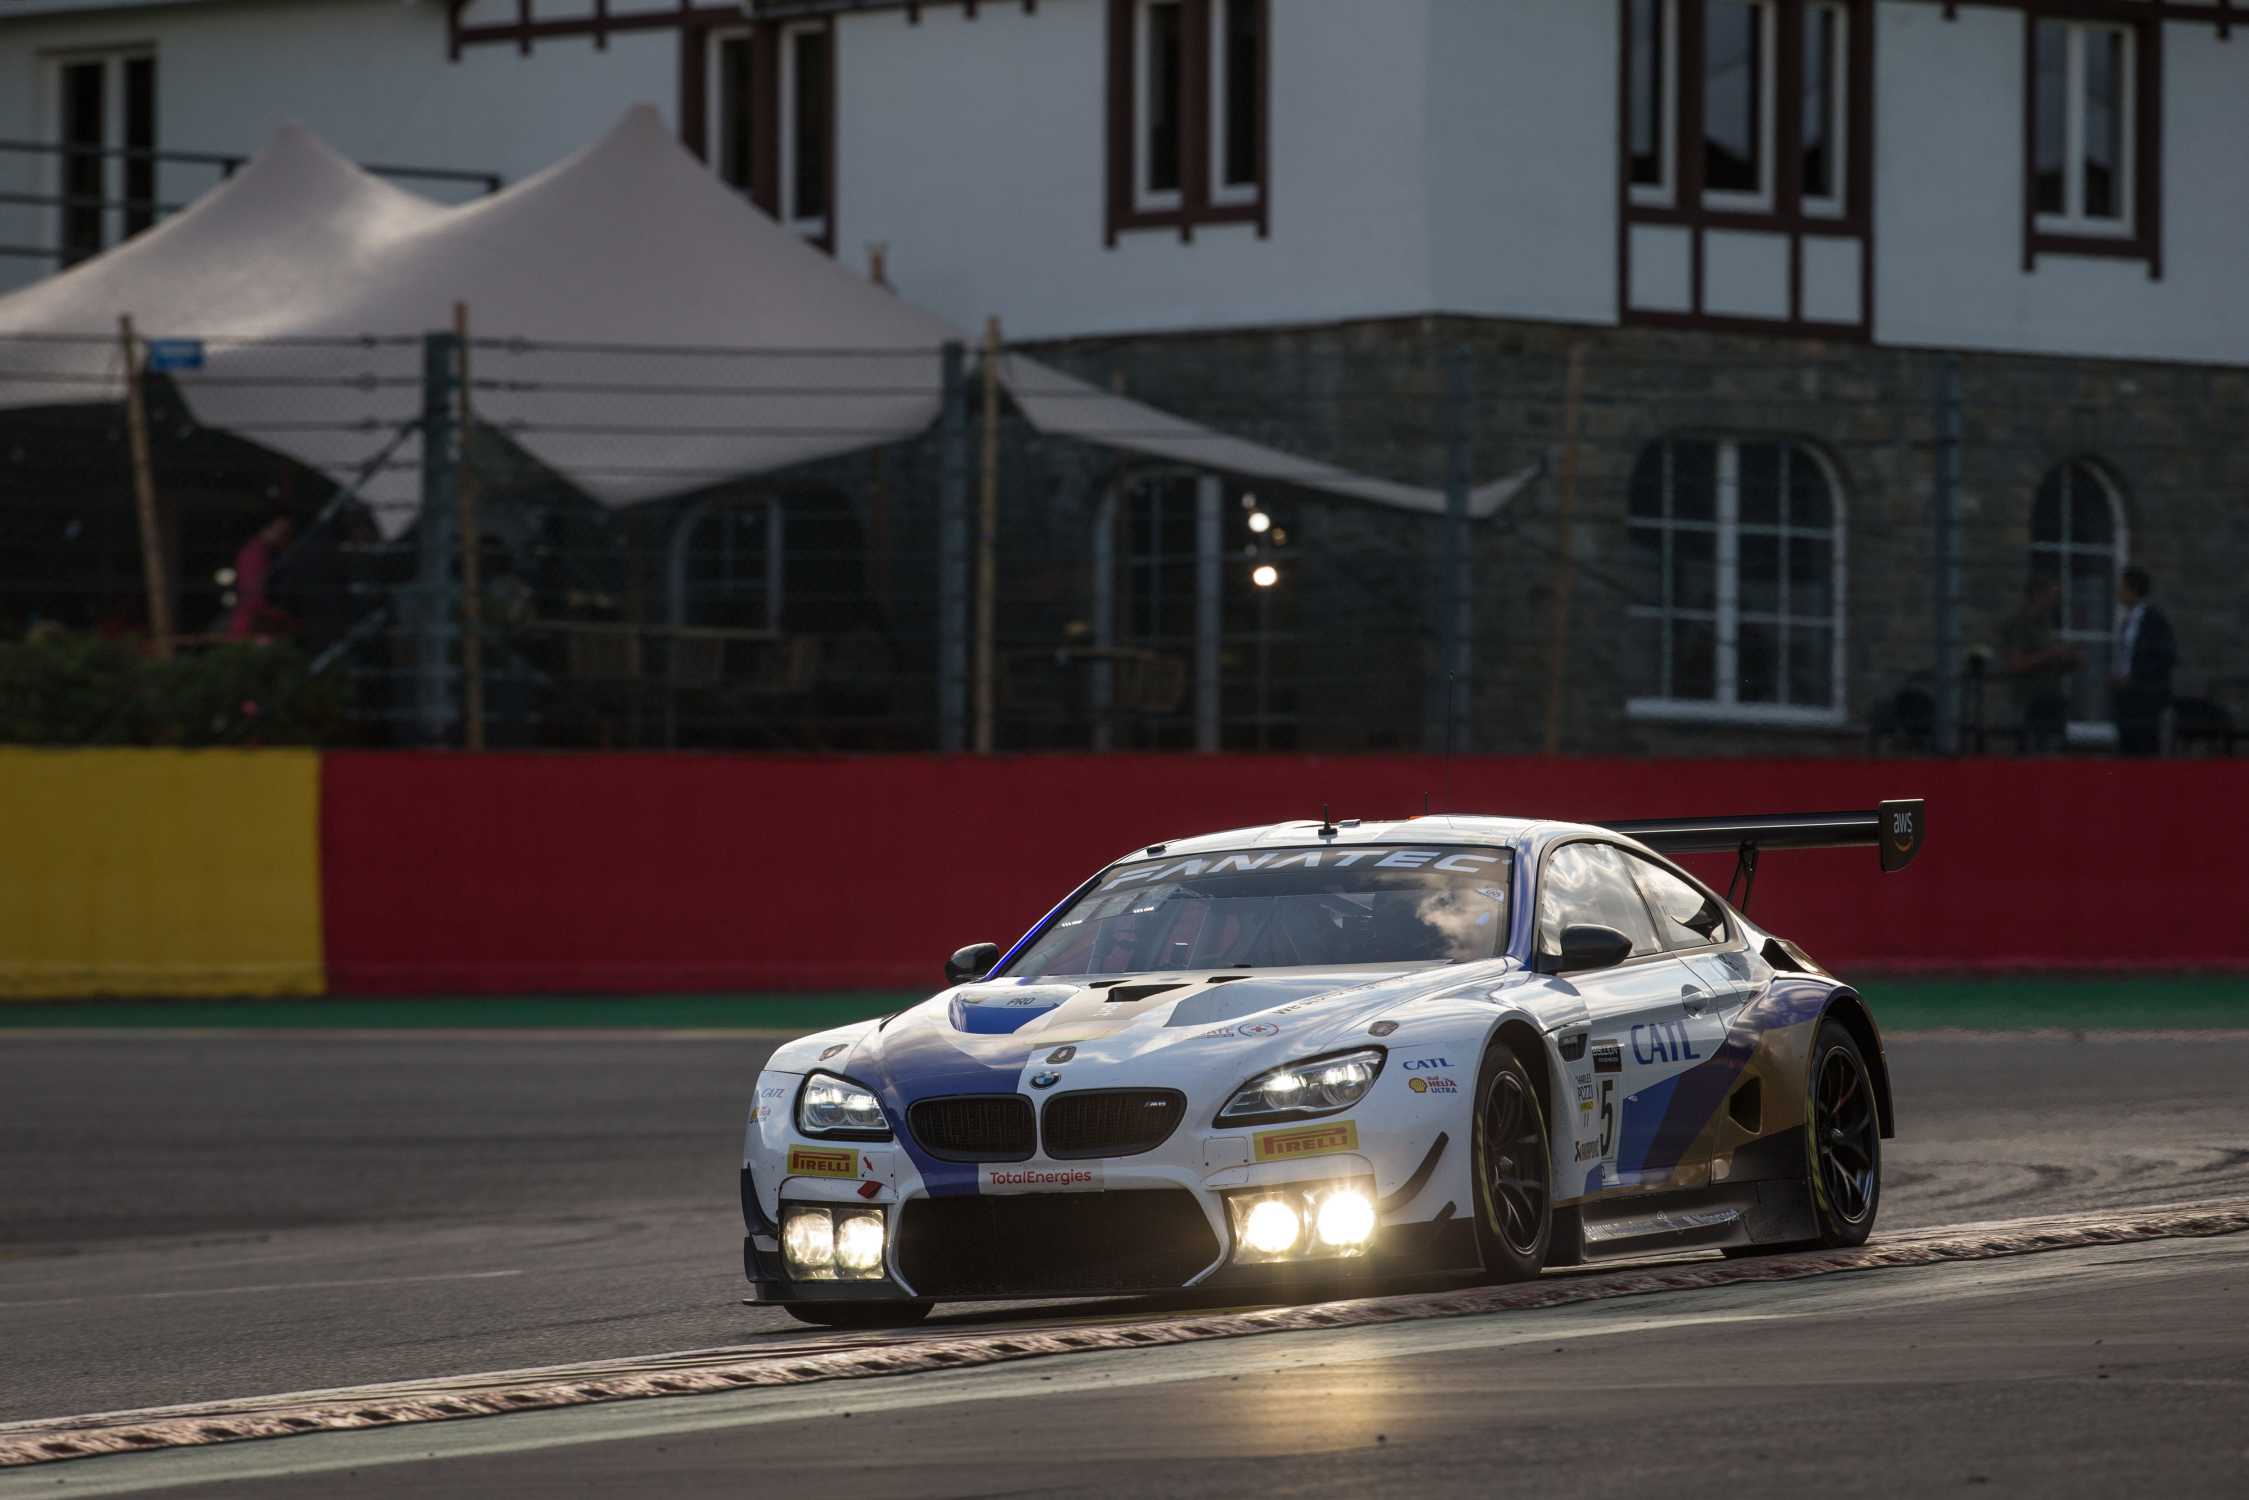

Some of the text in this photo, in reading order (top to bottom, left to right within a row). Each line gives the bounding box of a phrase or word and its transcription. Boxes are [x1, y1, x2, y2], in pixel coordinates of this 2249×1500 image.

[1893, 812, 1913, 833] aws
[1102, 850, 1497, 891] FANATEC
[1631, 1021, 1701, 1065] CATL
[1402, 1057, 1457, 1070] CATL
[1427, 1079, 1457, 1087] HELIX
[1600, 1079, 1614, 1156] 5
[1263, 1127, 1348, 1155] PIRELLI
[792, 1150, 851, 1173] PIRELLI
[989, 1169, 1092, 1186] TotalEnergies
